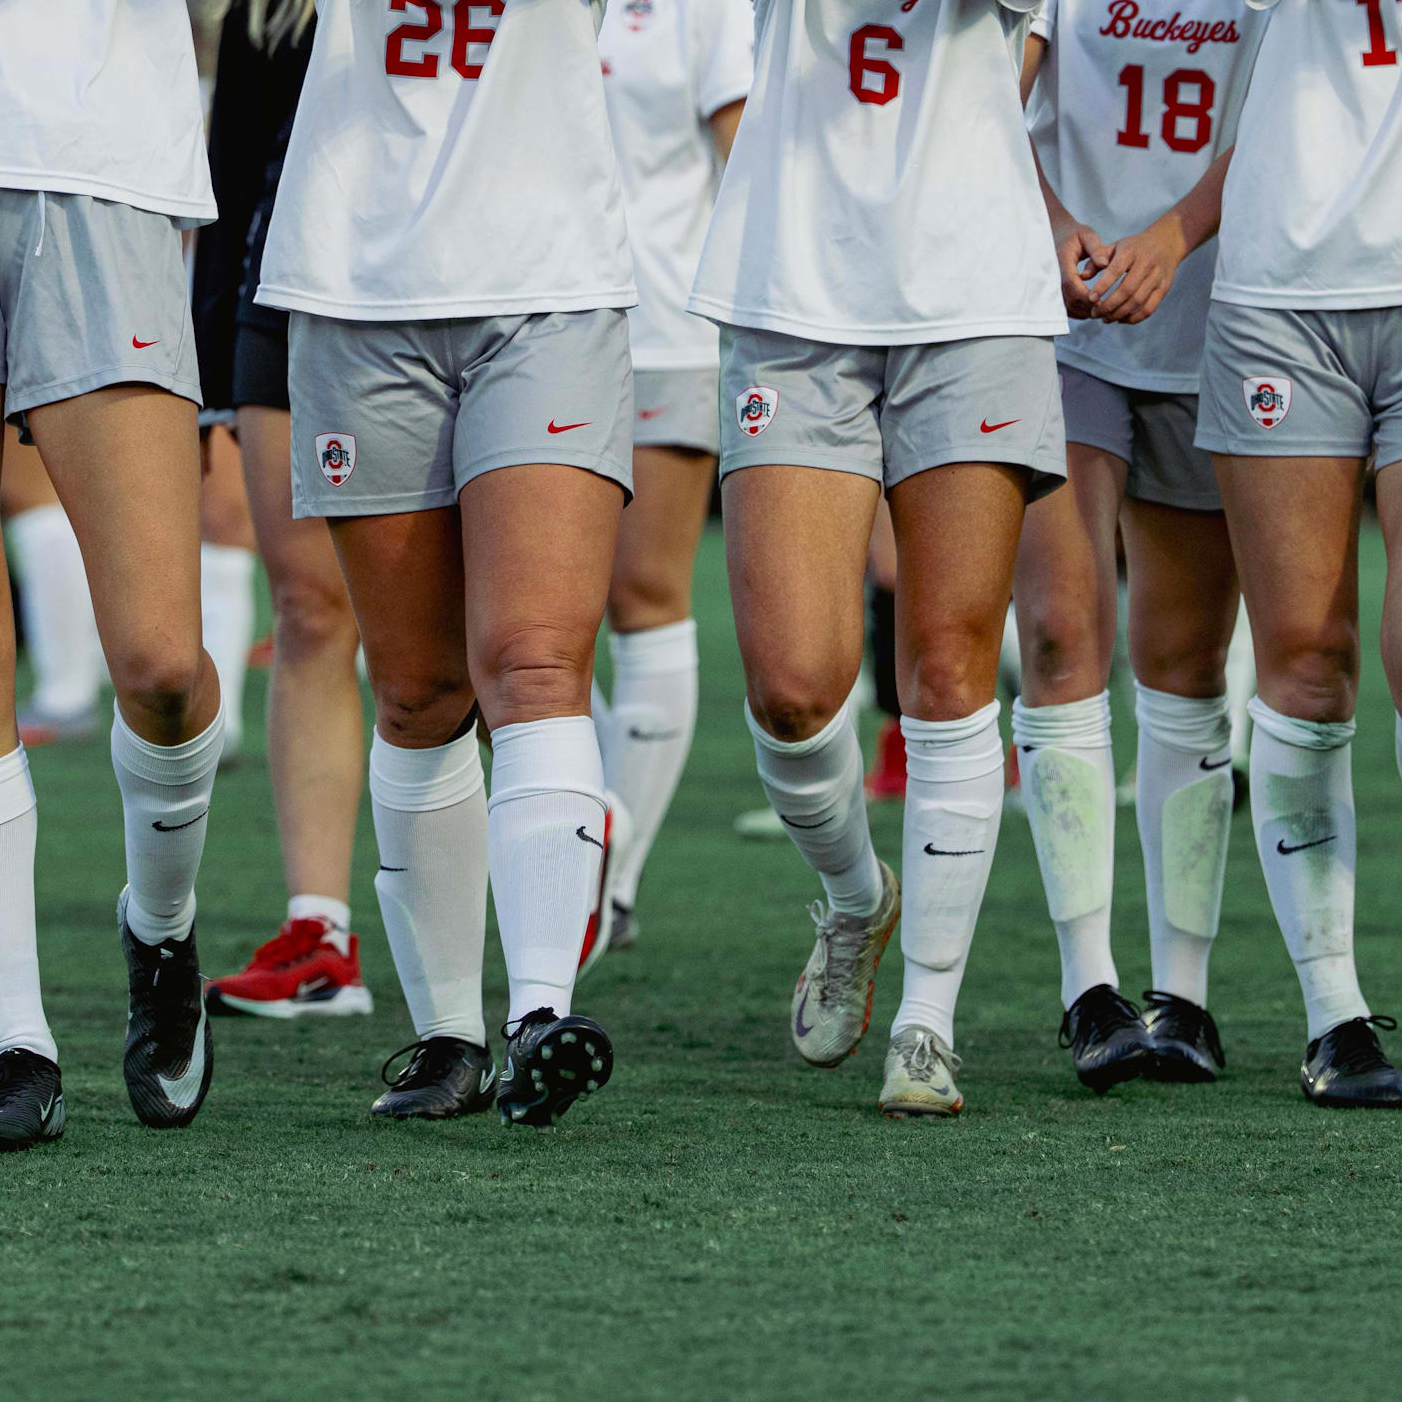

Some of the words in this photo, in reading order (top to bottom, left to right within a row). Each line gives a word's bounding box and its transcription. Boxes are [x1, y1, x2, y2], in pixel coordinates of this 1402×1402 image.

[848, 22, 905, 107] 6
[1099, 0, 1241, 54] Buckeyes
[1116, 64, 1216, 154] 18
